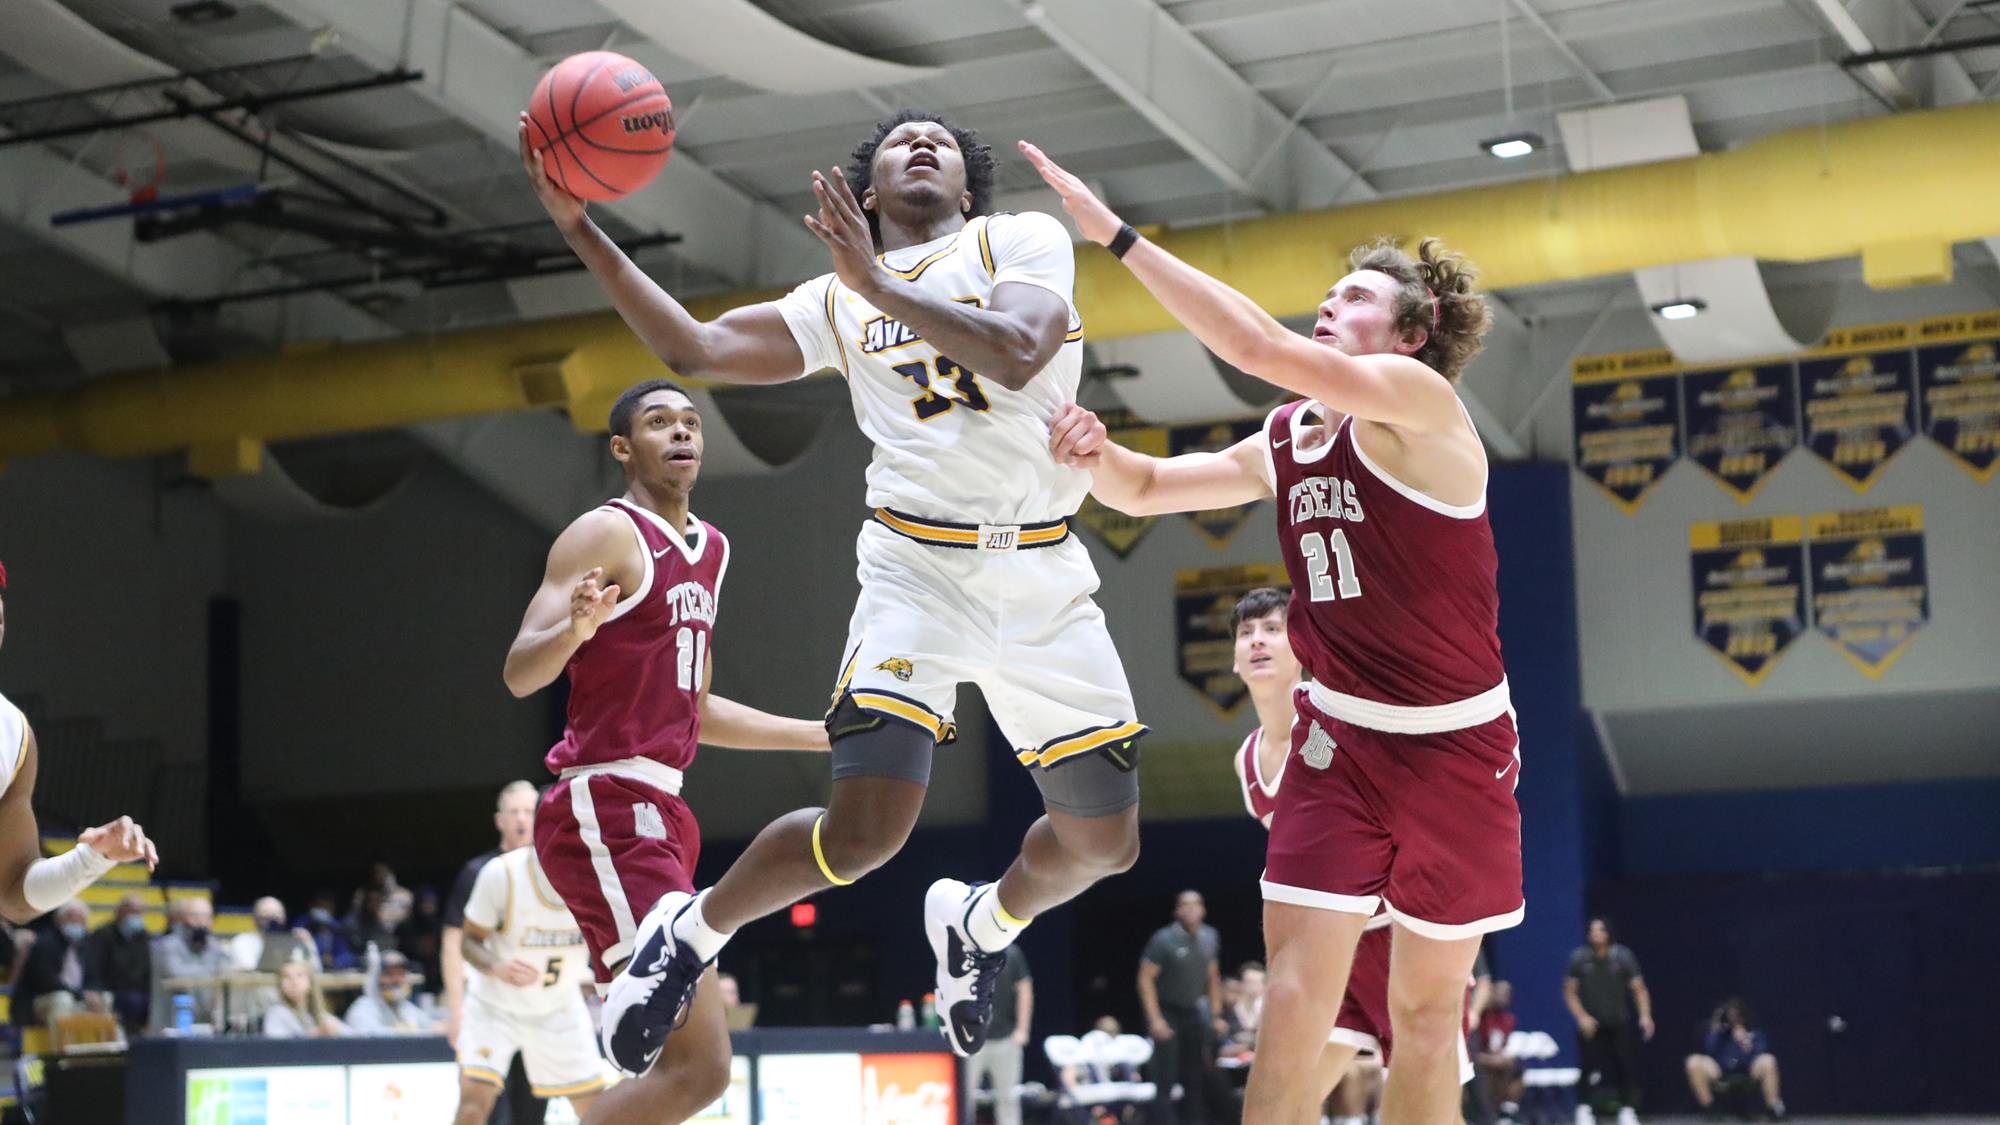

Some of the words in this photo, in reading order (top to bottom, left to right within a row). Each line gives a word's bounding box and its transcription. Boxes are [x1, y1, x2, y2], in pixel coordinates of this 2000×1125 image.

[622, 109, 676, 136] ilson
[891, 354, 992, 423] 33
[1288, 475, 1365, 527] TGERS
[986, 532, 1014, 549] AU
[1299, 528, 1363, 603] 21
[543, 956, 564, 988] 5
